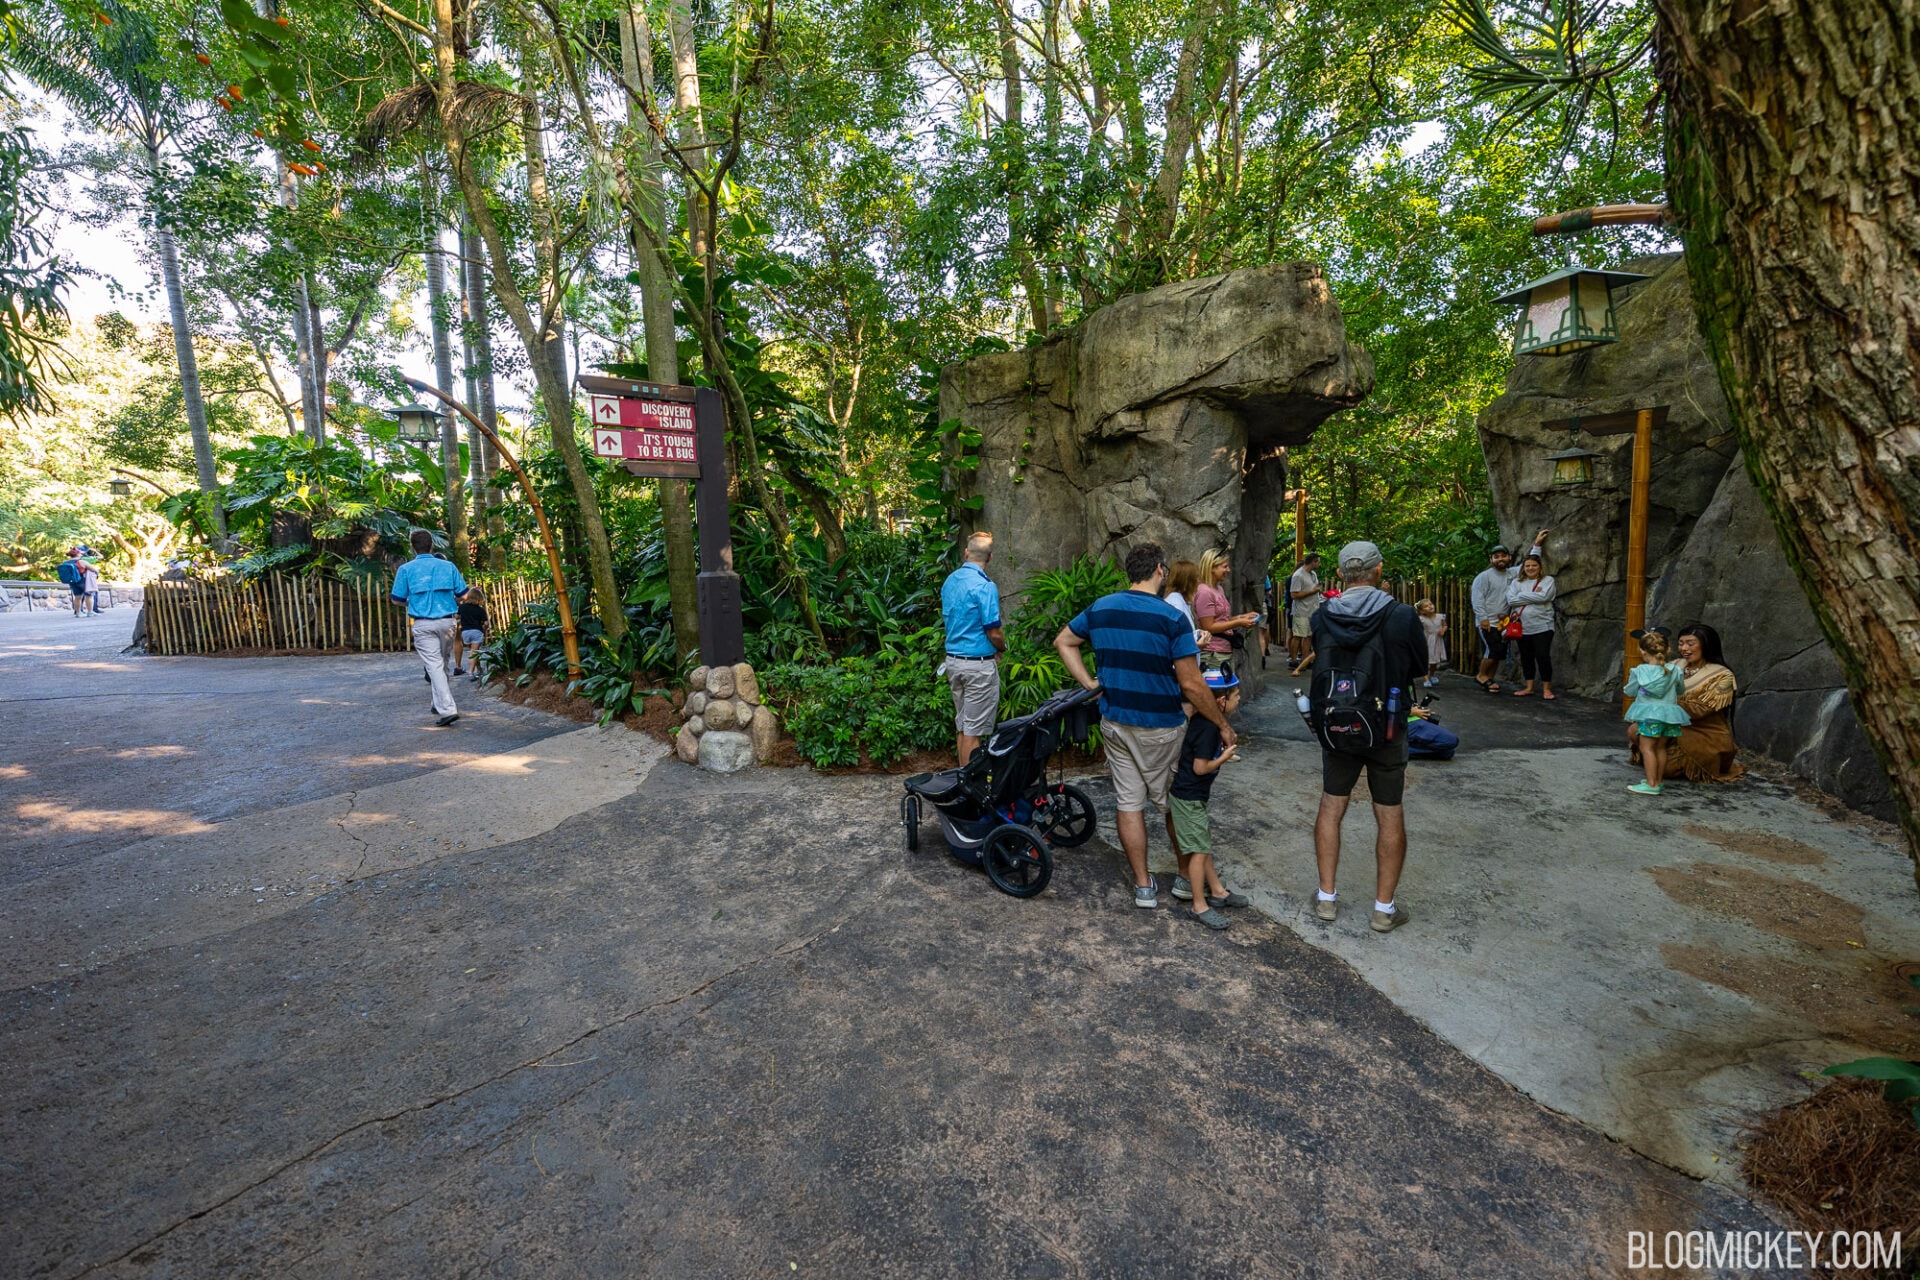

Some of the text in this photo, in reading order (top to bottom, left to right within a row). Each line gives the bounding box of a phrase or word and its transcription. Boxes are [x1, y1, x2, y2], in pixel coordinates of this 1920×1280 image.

[641, 403, 691, 418] DISCOVERY
[659, 416, 692, 430] ISLAND
[643, 434, 693, 447] IT'S TOUGH
[637, 445, 694, 459] TO BE A BUG
